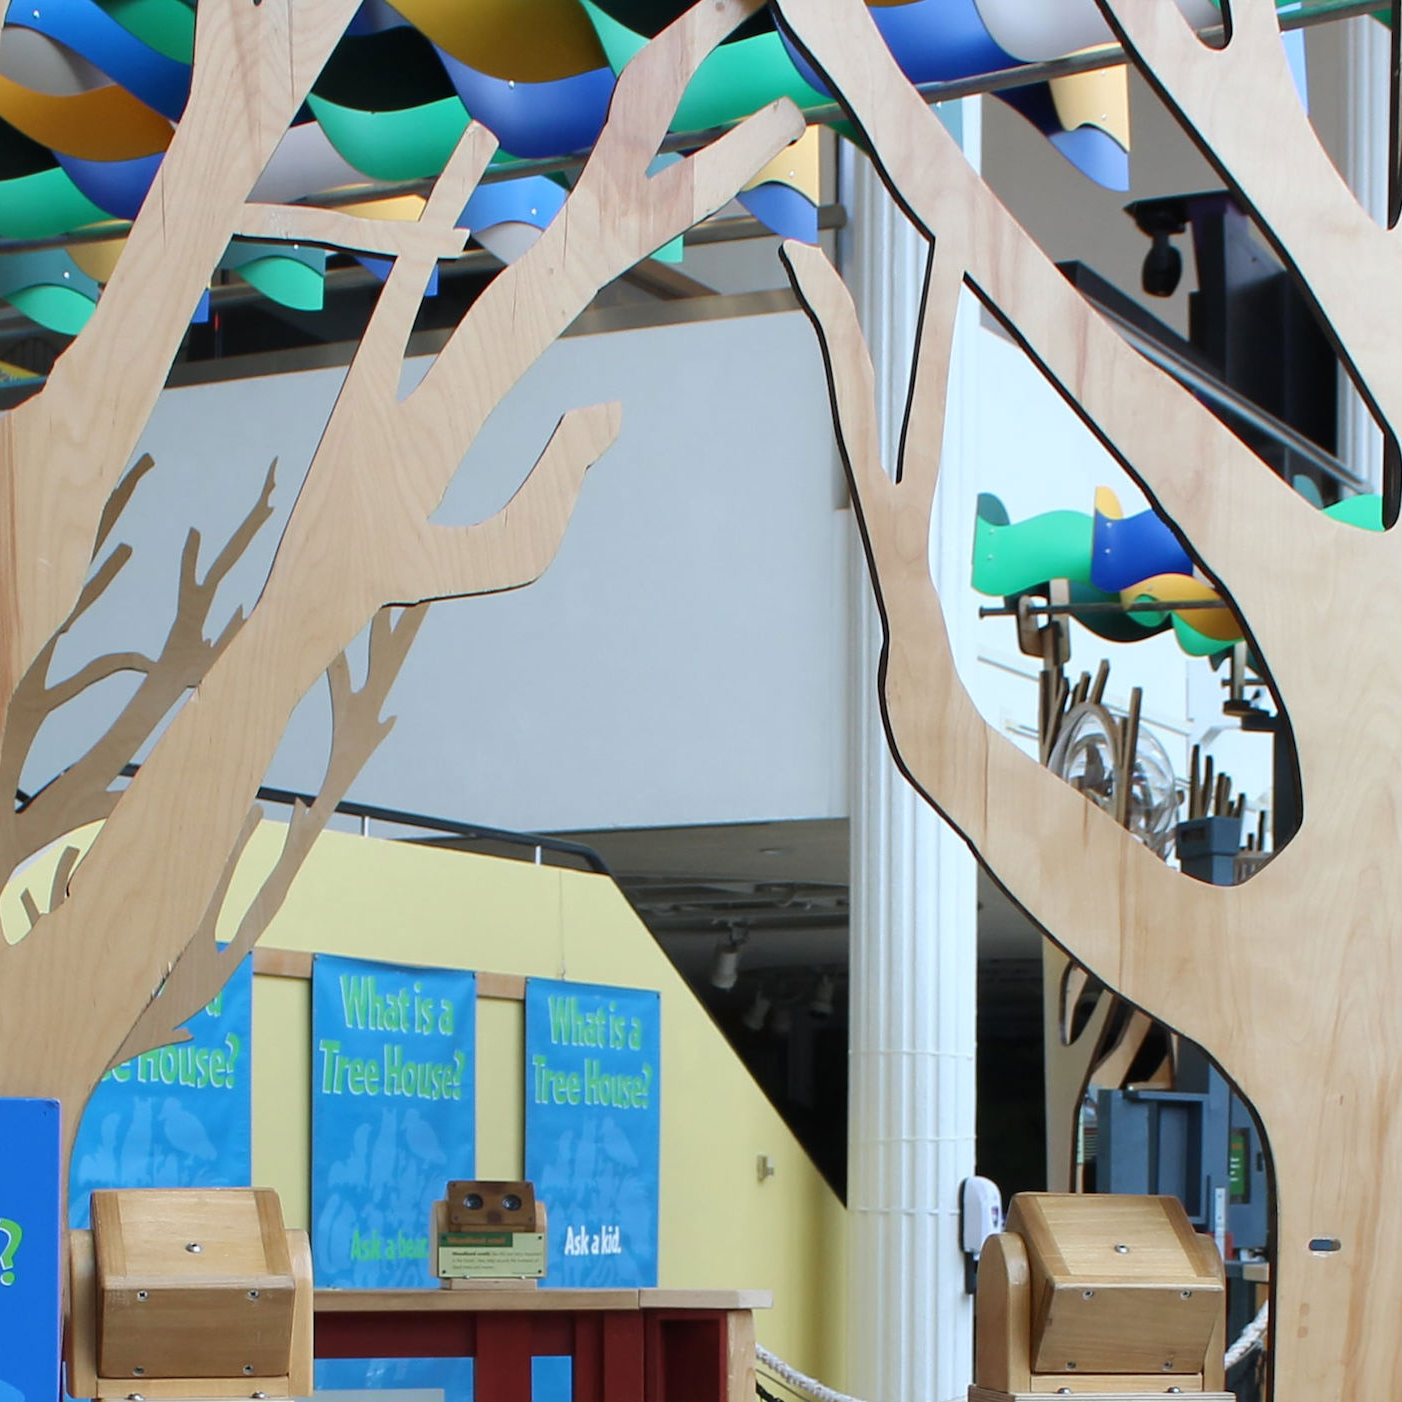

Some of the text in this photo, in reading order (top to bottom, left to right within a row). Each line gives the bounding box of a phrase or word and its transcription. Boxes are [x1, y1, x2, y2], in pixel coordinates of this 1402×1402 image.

[339, 974, 454, 1036] What is a
[548, 995, 641, 1050] What is a
[319, 1039, 466, 1101] Tree House?
[533, 1054, 653, 1109] Tree House?
[350, 1229, 382, 1261] Ask
[387, 1238, 395, 1260] a
[564, 1225, 621, 1255] Ask a kid.
